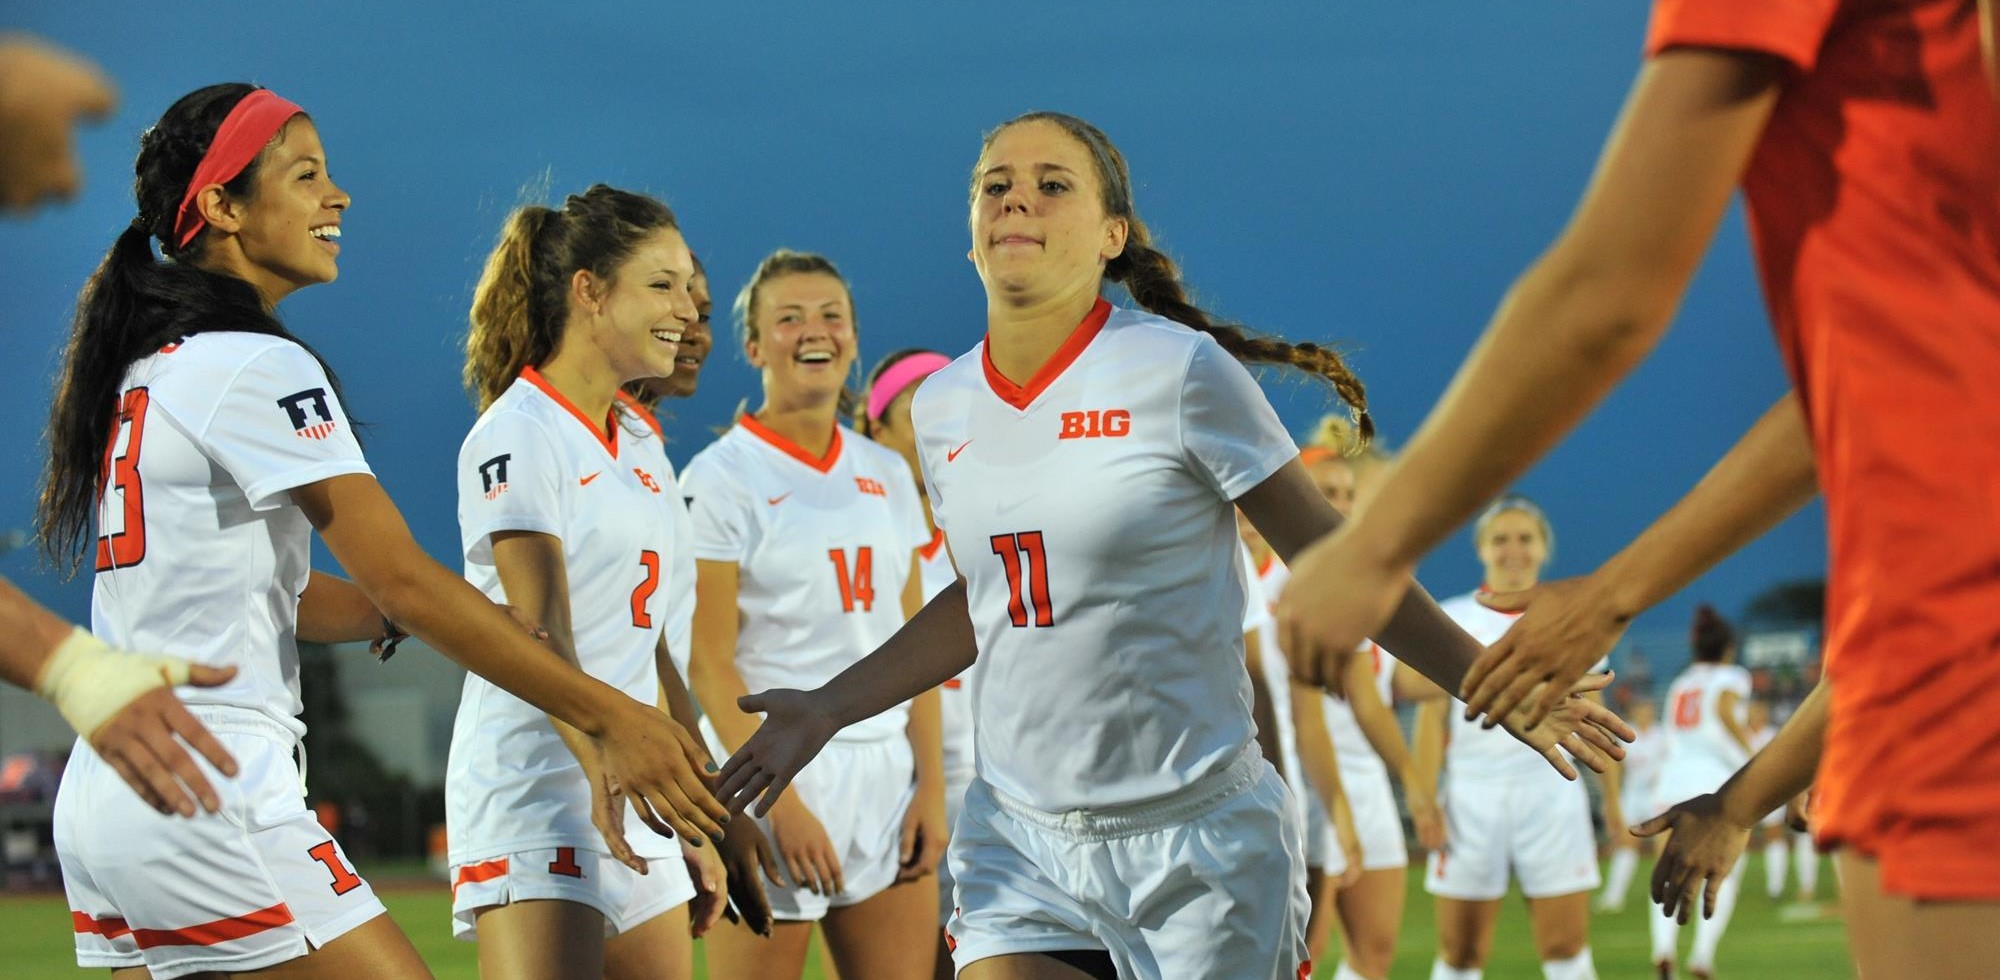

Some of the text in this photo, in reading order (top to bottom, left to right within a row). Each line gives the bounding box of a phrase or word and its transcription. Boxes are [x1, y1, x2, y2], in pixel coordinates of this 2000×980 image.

[630, 549, 660, 629] 2
[828, 546, 875, 613] 14
[990, 530, 1054, 628] 11
